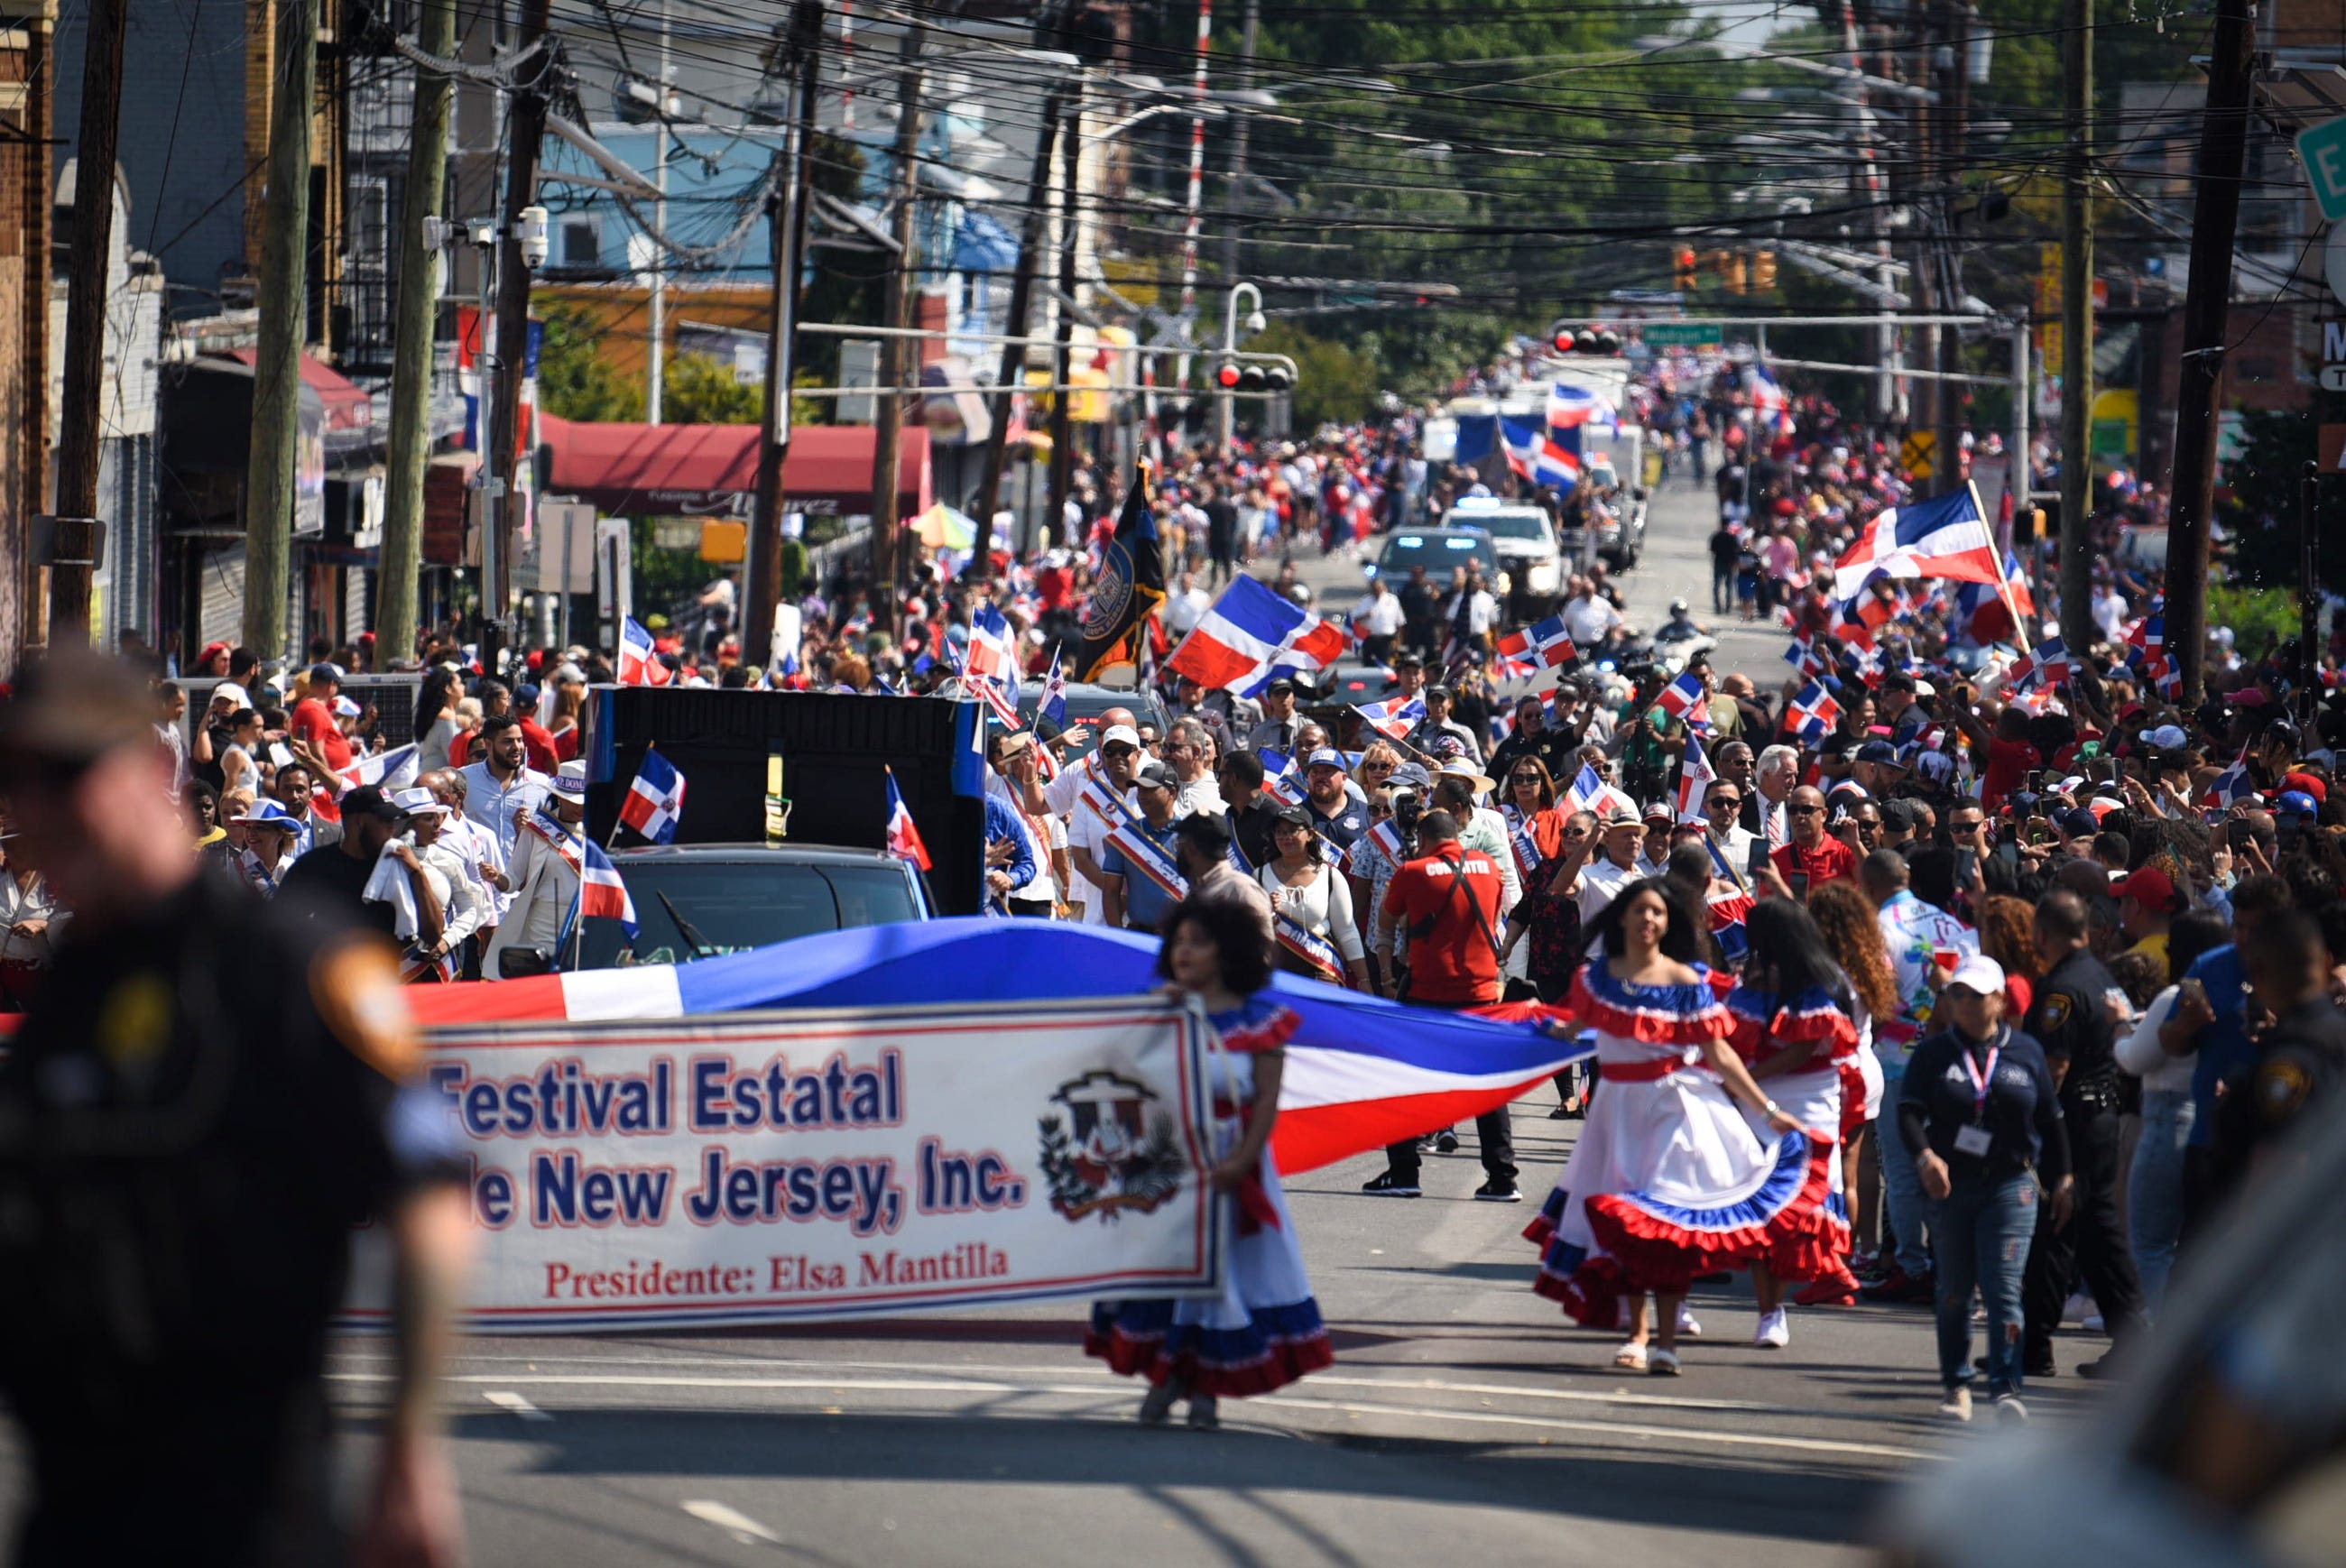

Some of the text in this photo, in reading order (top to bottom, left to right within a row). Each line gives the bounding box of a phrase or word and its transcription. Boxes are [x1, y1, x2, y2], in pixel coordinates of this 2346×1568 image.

[428, 1050, 901, 1136] Festival Estatal
[533, 1151, 673, 1226] New
[686, 1148, 901, 1236] Jersey,
[919, 1139, 1026, 1213] Inc.
[543, 1241, 1009, 1299] Presidente: Elsa Mantilla
